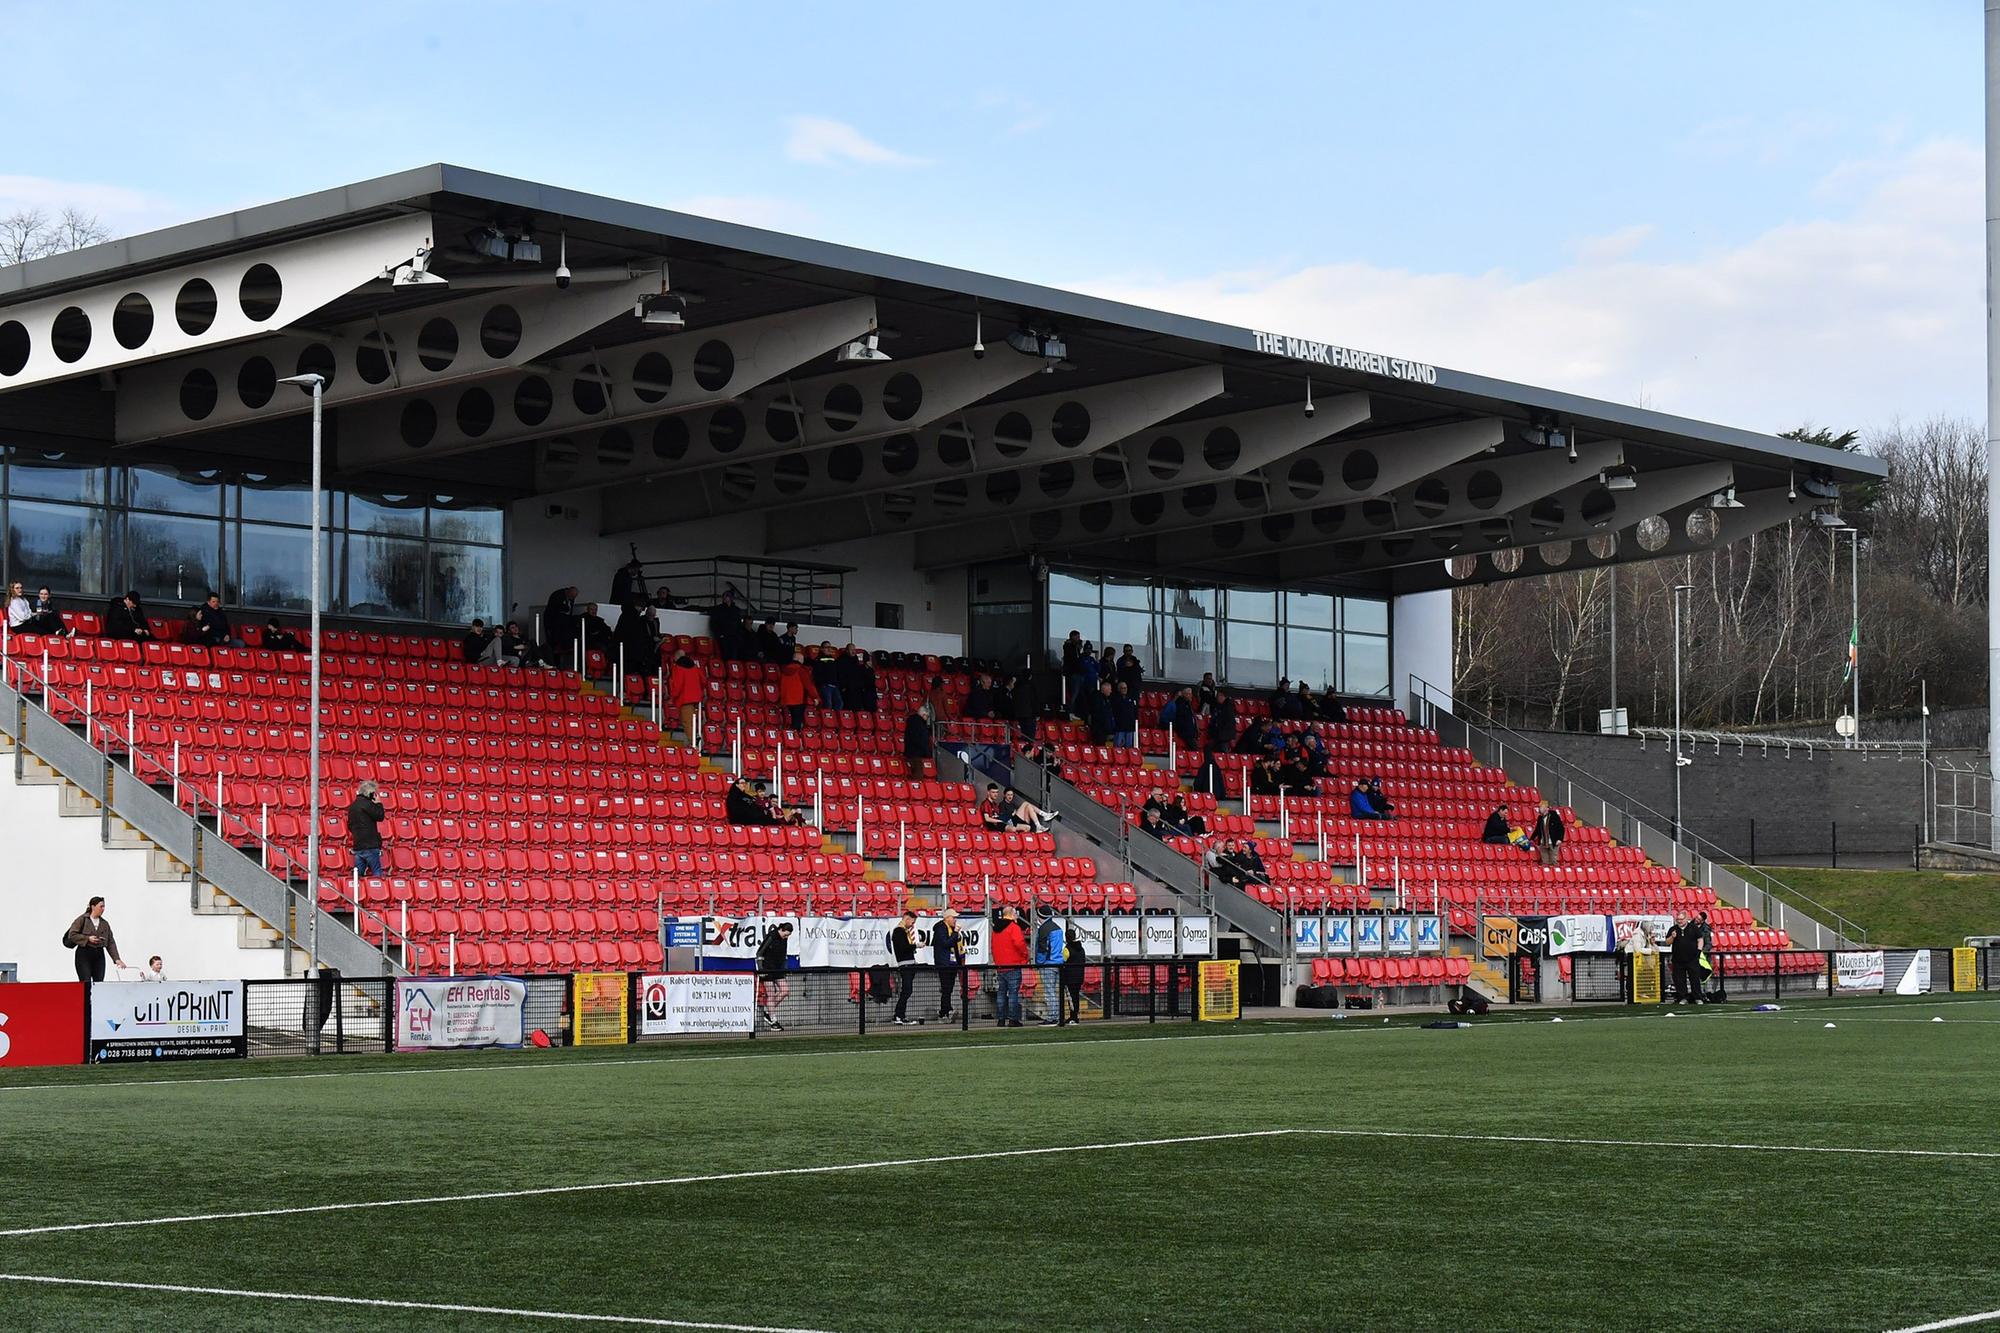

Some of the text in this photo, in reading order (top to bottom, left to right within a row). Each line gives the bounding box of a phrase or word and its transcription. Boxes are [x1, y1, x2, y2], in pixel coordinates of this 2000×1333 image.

[1253, 330, 1437, 385] THE MARK FARREN STAND
[859, 927, 884, 940] DUFFY
[918, 929, 979, 947] DIND
[1111, 926, 1137, 942] Ogma
[1147, 926, 1172, 942] Ogma
[1182, 925, 1207, 942] Ogma
[1488, 928, 1547, 945] CITY CABS
[669, 976, 690, 985] Robert
[691, 976, 714, 986] Quigley
[715, 976, 733, 985] Estate
[733, 977, 753, 986] Agents
[447, 985, 510, 1002] EH Rentals
[692, 991, 732, 1000] 028 7134 1992
[716, 1005, 752, 1013] VALUATIONS
[409, 1007, 432, 1031] EH
[679, 1019, 748, 1029] www.robertquigley.co.uk
[177, 1024, 229, 1034] DESIGN PRINT
[410, 1032, 432, 1041] Rentals
[107, 1050, 120, 1058] 028
[163, 1047, 236, 1057] www.cityprintderry.com
